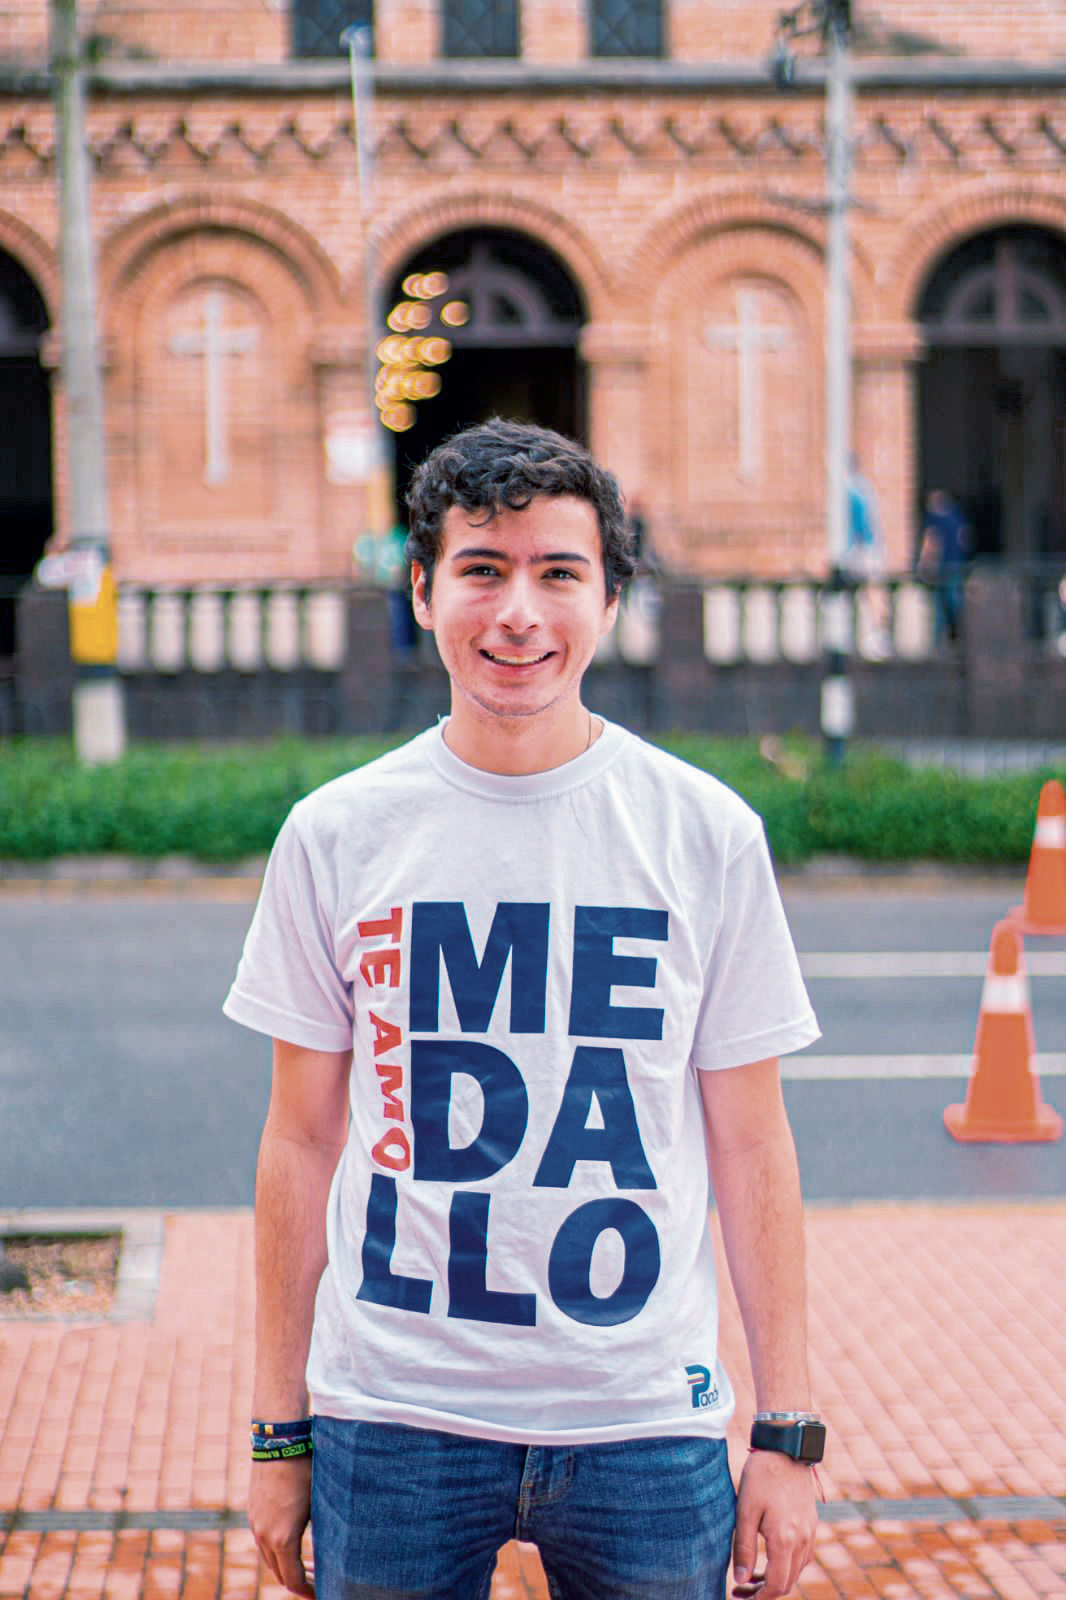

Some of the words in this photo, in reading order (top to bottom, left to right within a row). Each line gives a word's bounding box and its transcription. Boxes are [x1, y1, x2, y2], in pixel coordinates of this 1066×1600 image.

[357, 906, 403, 988] TE
[409, 901, 669, 1040] ME
[368, 1010, 411, 1172] AMO
[410, 1040, 658, 1190] DA
[356, 1172, 661, 1327] LLO
